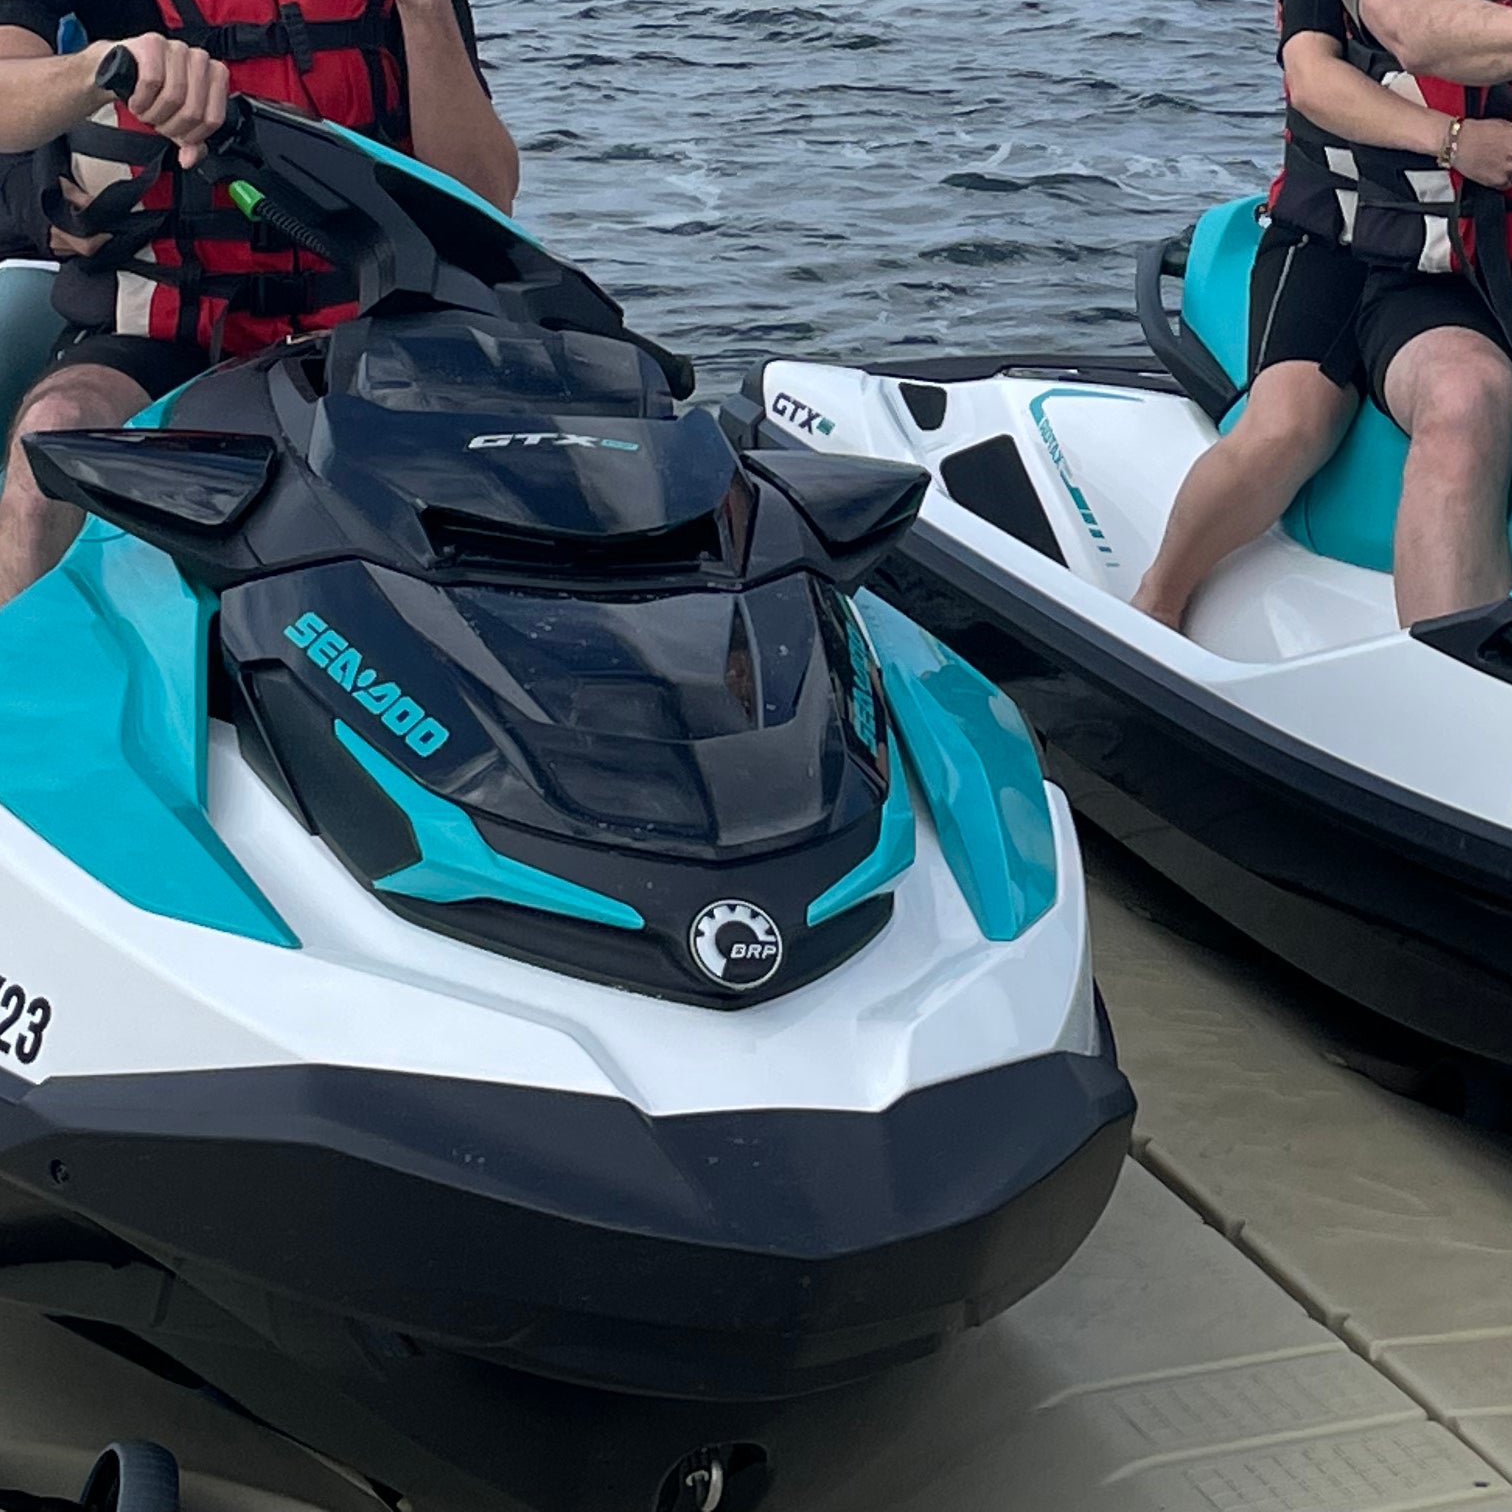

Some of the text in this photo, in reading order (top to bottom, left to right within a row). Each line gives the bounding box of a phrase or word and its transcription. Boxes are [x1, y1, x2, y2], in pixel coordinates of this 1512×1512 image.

[772, 392, 821, 435] GTX
[467, 433, 598, 449] GTX
[730, 943, 777, 960] BRP
[0, 974, 52, 1065] 23
